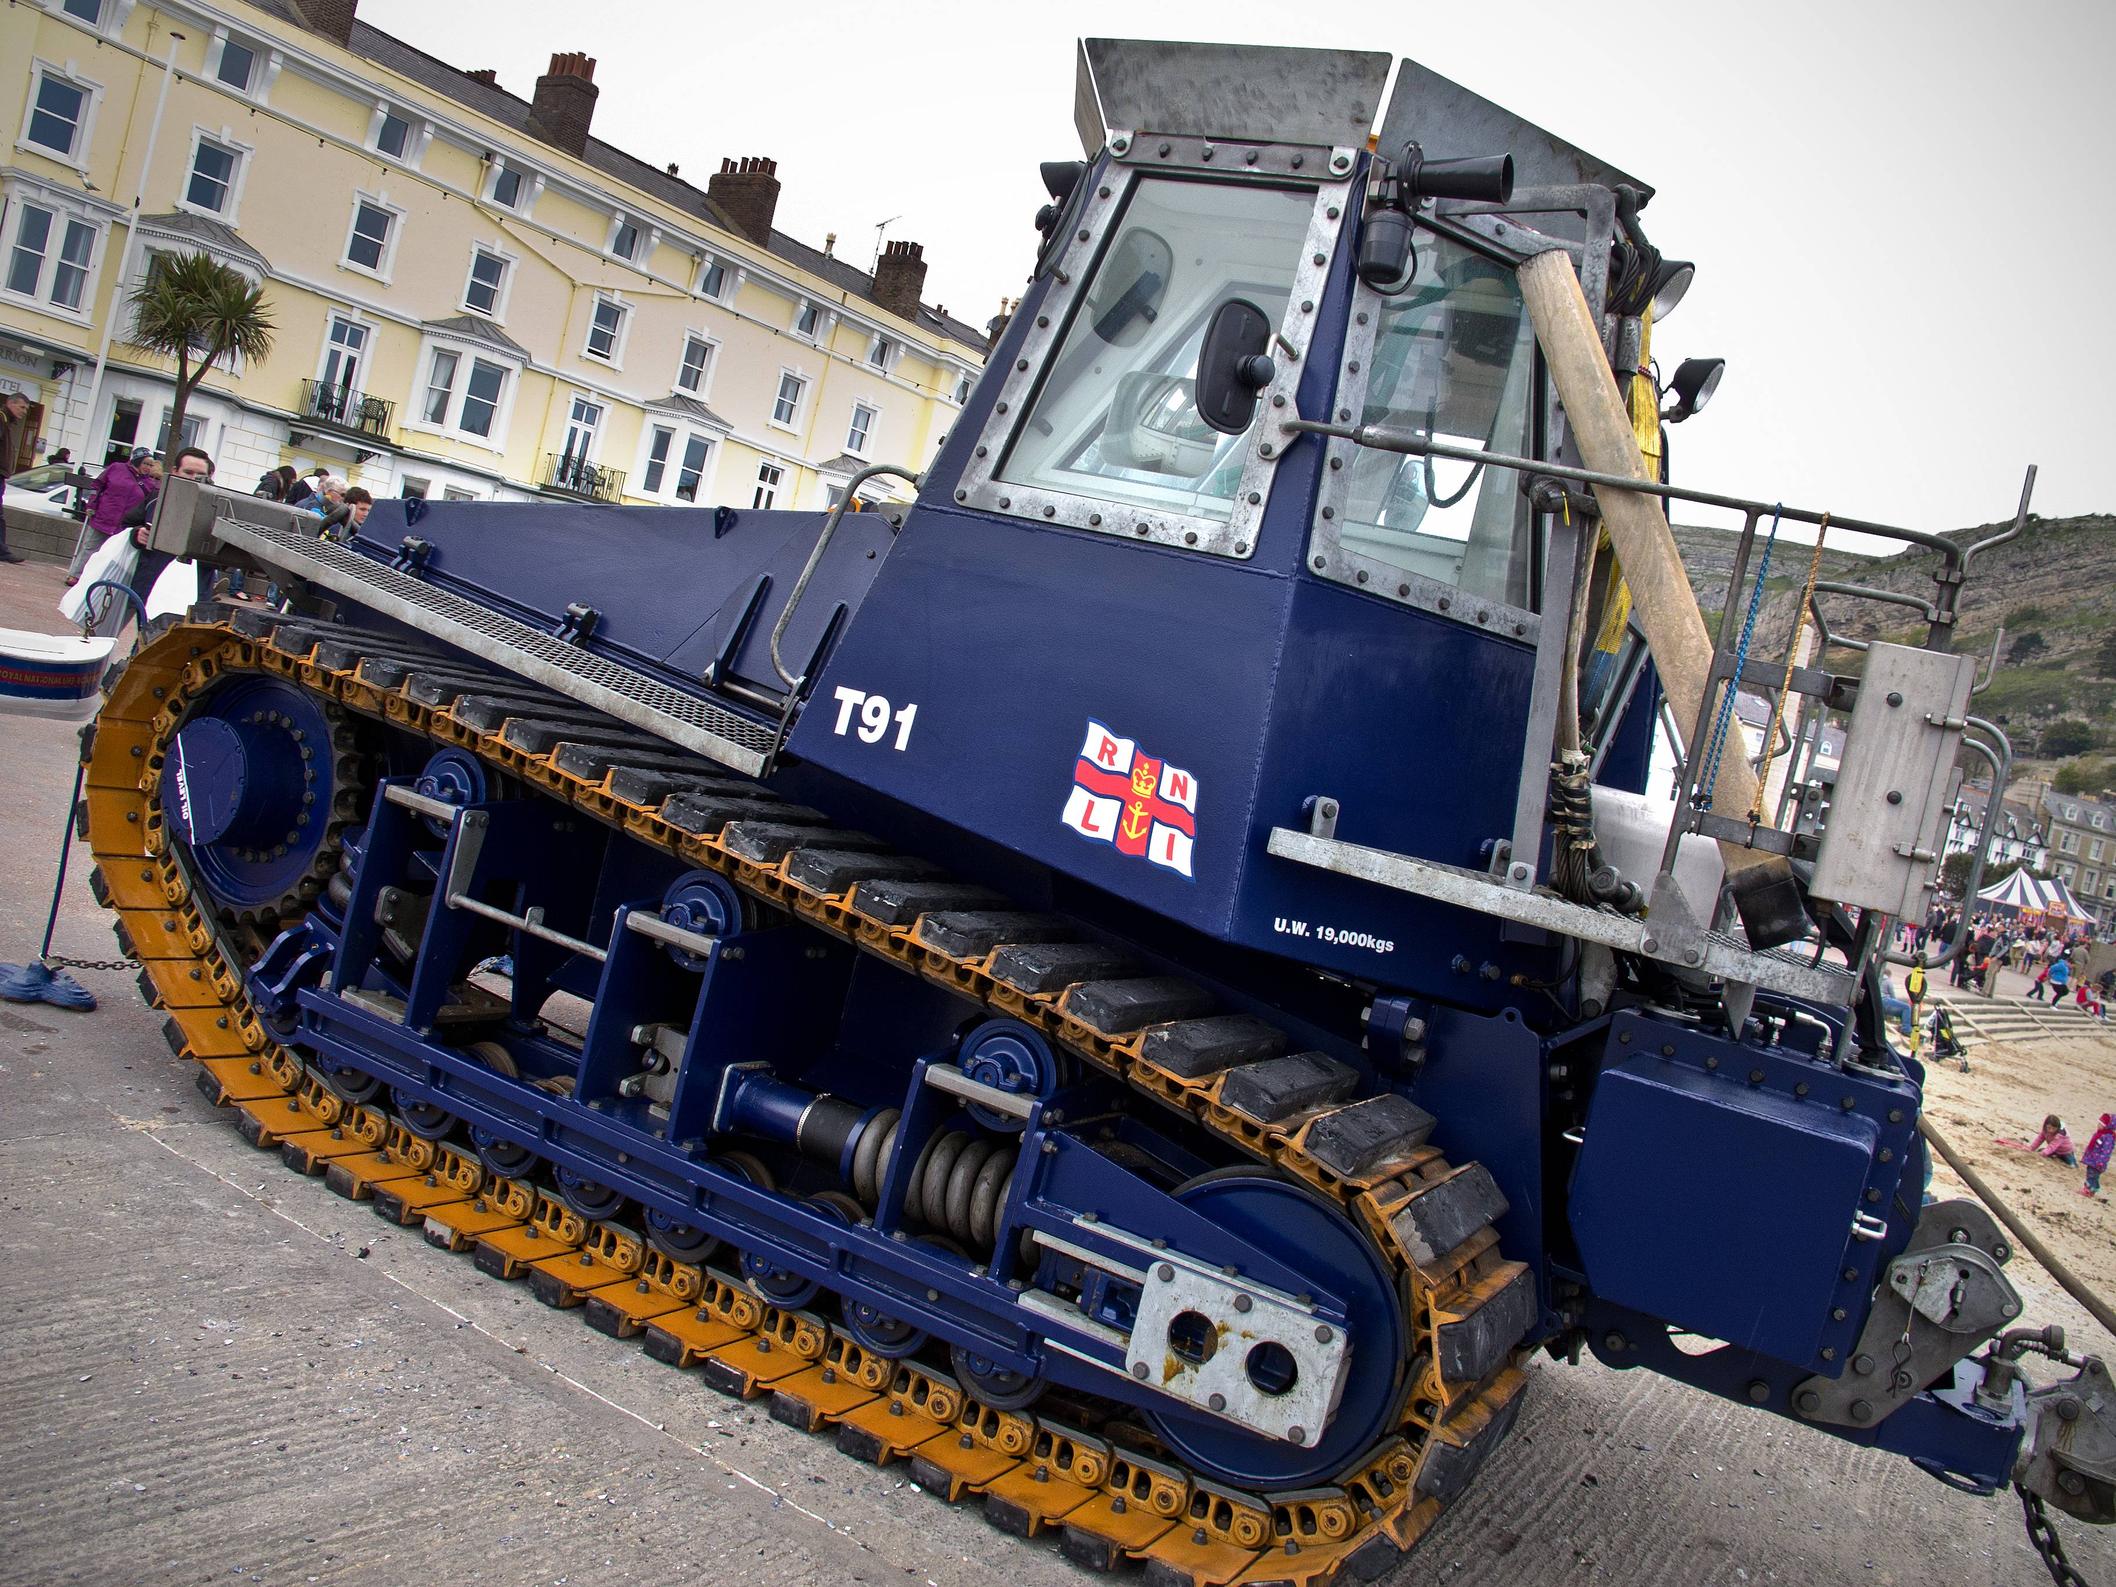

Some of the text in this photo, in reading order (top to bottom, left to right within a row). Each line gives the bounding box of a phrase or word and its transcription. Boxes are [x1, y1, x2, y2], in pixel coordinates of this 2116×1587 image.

[0, 378, 23, 393] TEL
[834, 685, 918, 752] T91
[1097, 735, 1188, 800] R N
[176, 768, 189, 820] OIL LEVEL
[1273, 917, 1395, 953] U.W. 19,000kgs
